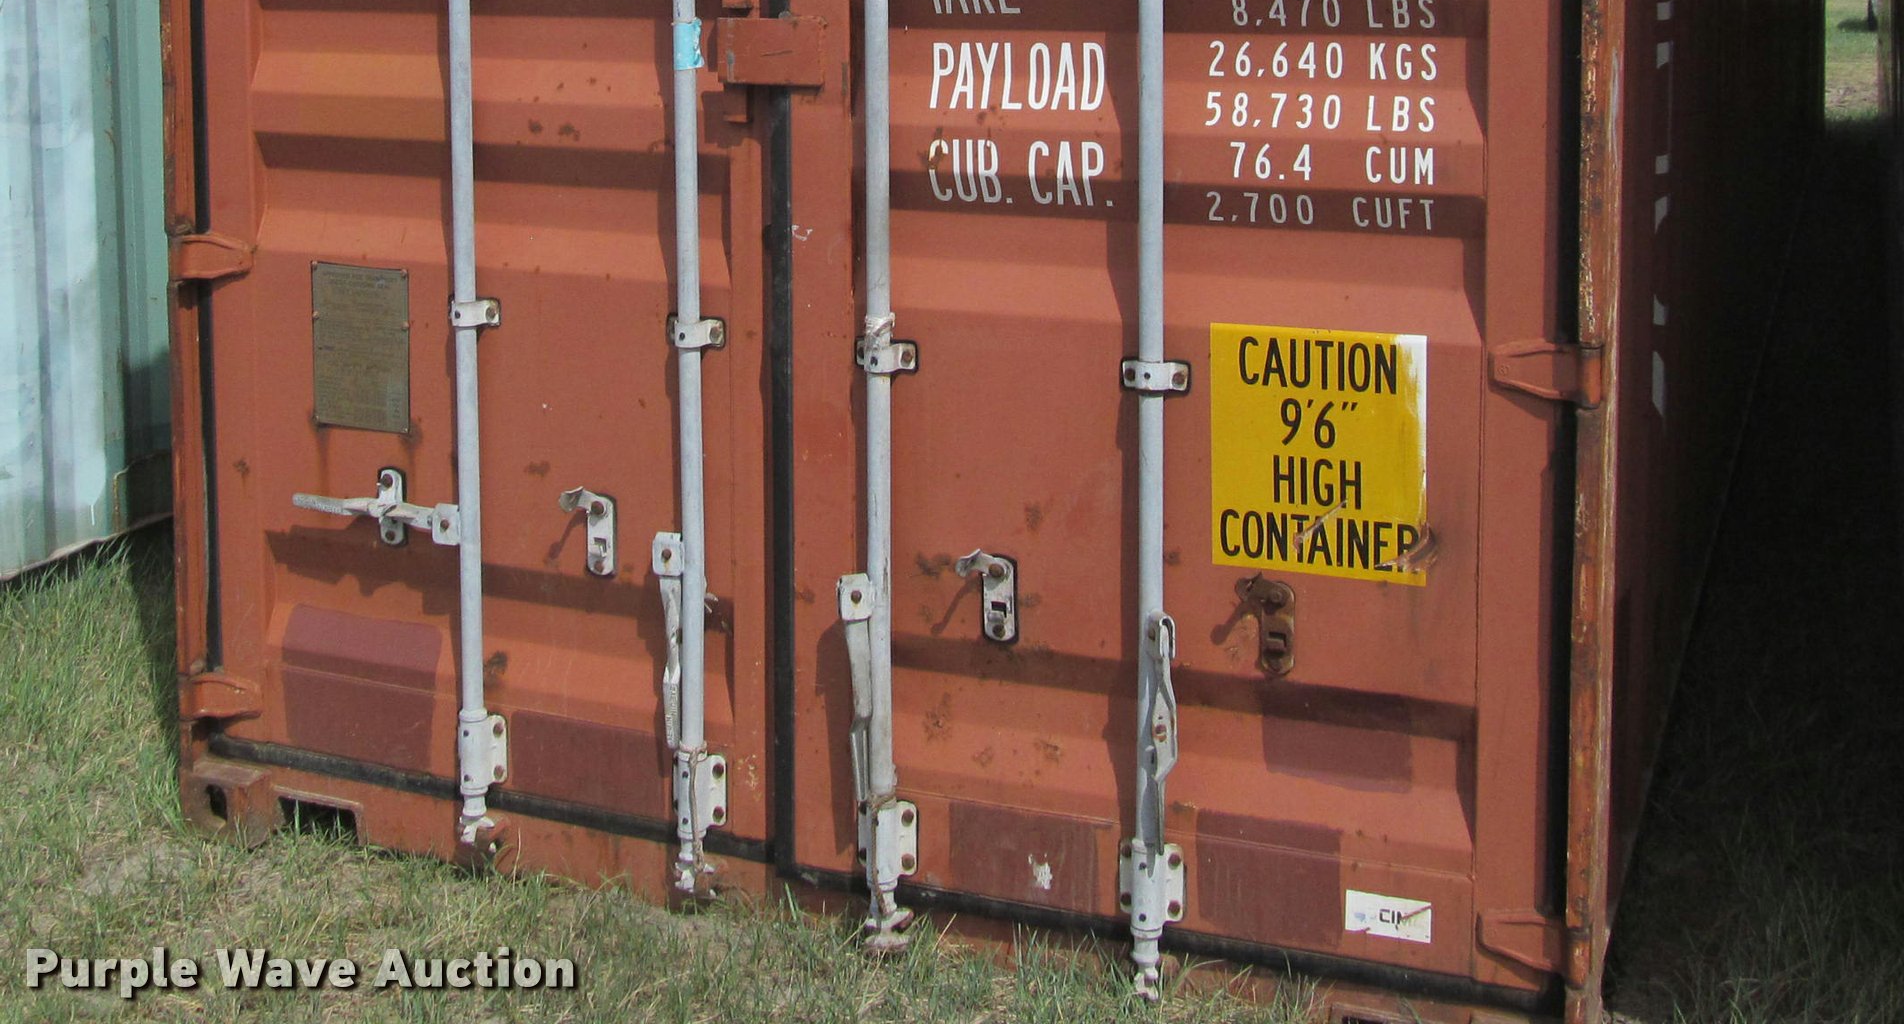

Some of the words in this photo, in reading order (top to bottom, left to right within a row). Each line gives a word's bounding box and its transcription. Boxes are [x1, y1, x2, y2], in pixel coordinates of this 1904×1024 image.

[929, 42, 1105, 111] PAYLOAD
[1208, 40, 1343, 79] 26,640
[1369, 42, 1437, 81] KGS
[1205, 91, 1341, 130] 58,730
[1366, 95, 1435, 132] LBS
[928, 139, 1013, 204] CUB.
[1028, 140, 1113, 207] CAP.
[1230, 141, 1312, 181] 76.4
[1365, 146, 1434, 185] CUM
[1206, 191, 1314, 225] 2,700
[1352, 196, 1434, 230] CUFT
[1238, 335, 1397, 395] CAUTION
[1273, 454, 1361, 510] HIGH
[1220, 508, 1419, 573] CONTAINER
